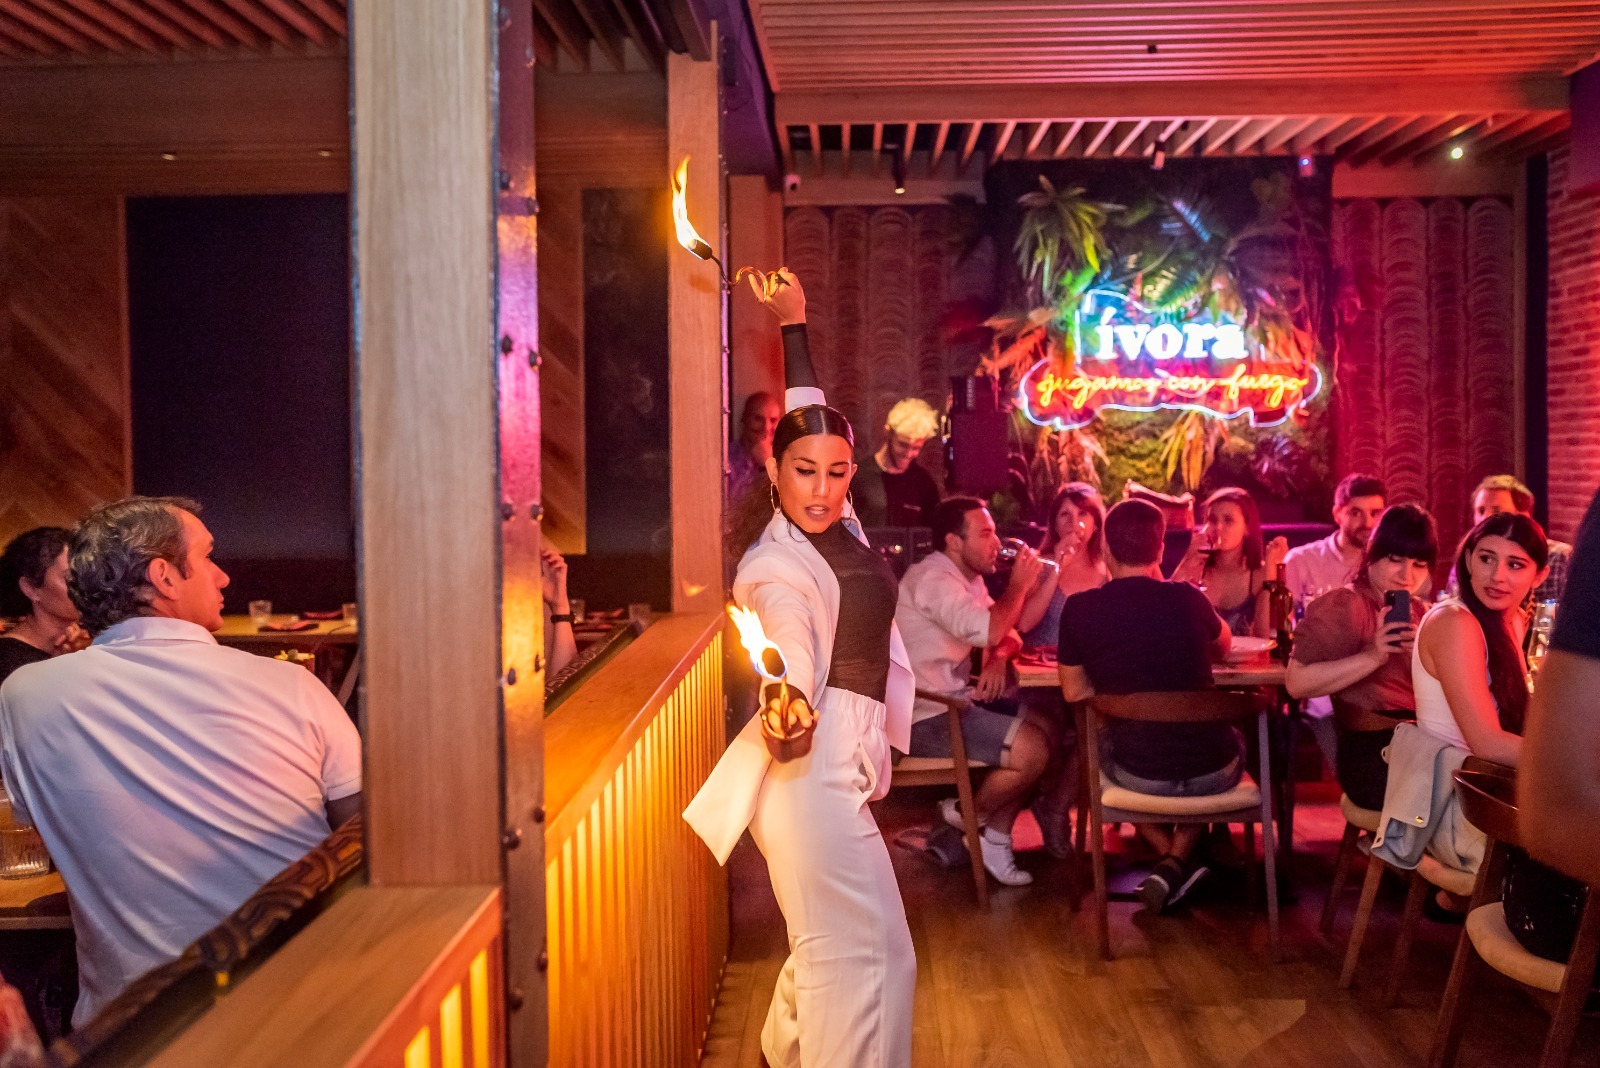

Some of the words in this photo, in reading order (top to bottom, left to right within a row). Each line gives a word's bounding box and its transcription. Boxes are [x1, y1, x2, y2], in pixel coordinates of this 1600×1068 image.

[1095, 306, 1249, 360] ívora
[1036, 373, 1161, 409] jugamos
[1167, 375, 1215, 391] con
[1219, 363, 1308, 408] fuego
